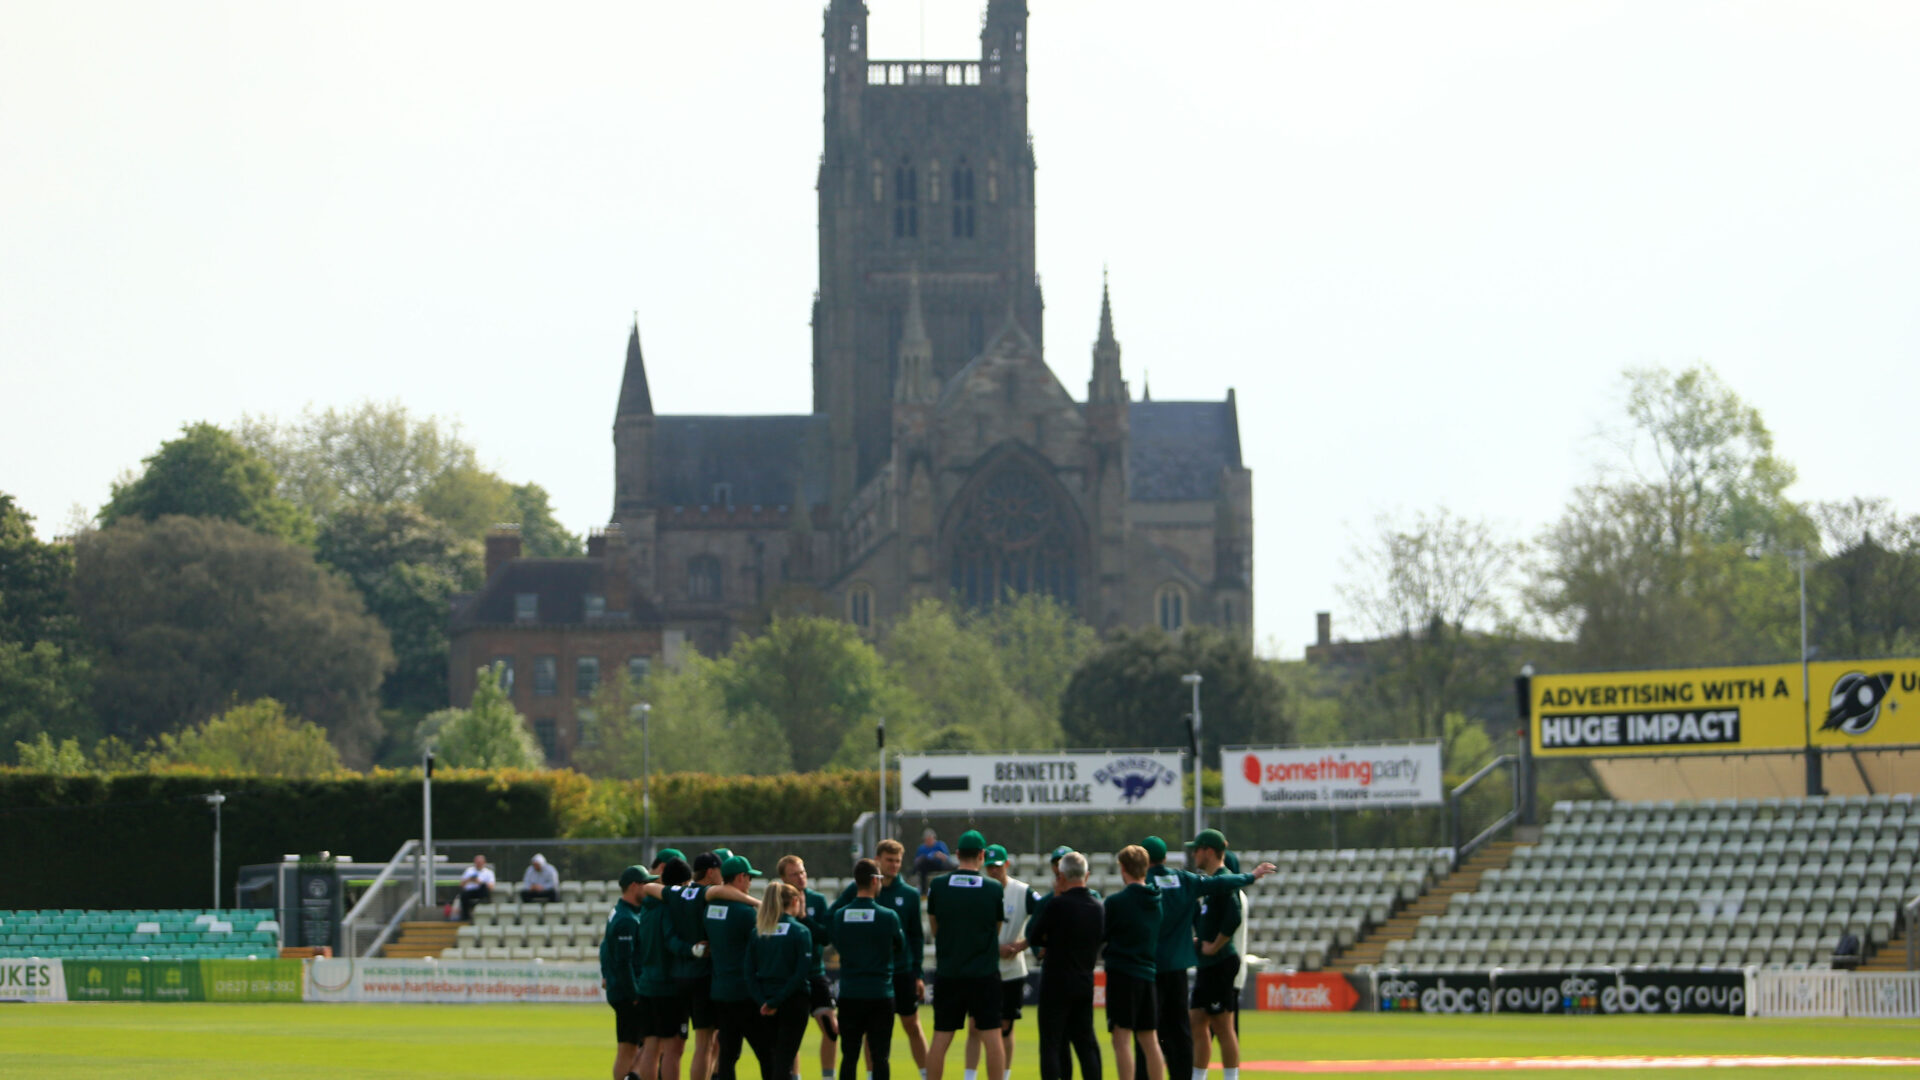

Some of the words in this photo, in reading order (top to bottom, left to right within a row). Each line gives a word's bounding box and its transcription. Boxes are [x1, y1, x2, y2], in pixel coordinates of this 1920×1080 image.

[1541, 683, 1694, 707] ADVERTISING
[1701, 679, 1765, 702] WITH
[1773, 677, 1790, 698] A
[1541, 714, 1620, 745] HUGE
[1626, 710, 1738, 742] IMPACT
[995, 761, 1077, 780] BENNETTS
[1093, 756, 1177, 785] BENNETTS
[982, 784, 1024, 803] FOOD
[1026, 783, 1091, 803] VILLAGE
[1261, 787, 1317, 801] balloons
[1333, 787, 1369, 800] more
[1267, 984, 1332, 1009] Mazak
[1380, 977, 1420, 997] ebc
[1421, 978, 1476, 1013] ebc
[1561, 975, 1598, 996] ebc
[1602, 976, 1661, 1013] ebc
[1665, 985, 1744, 1013] group
